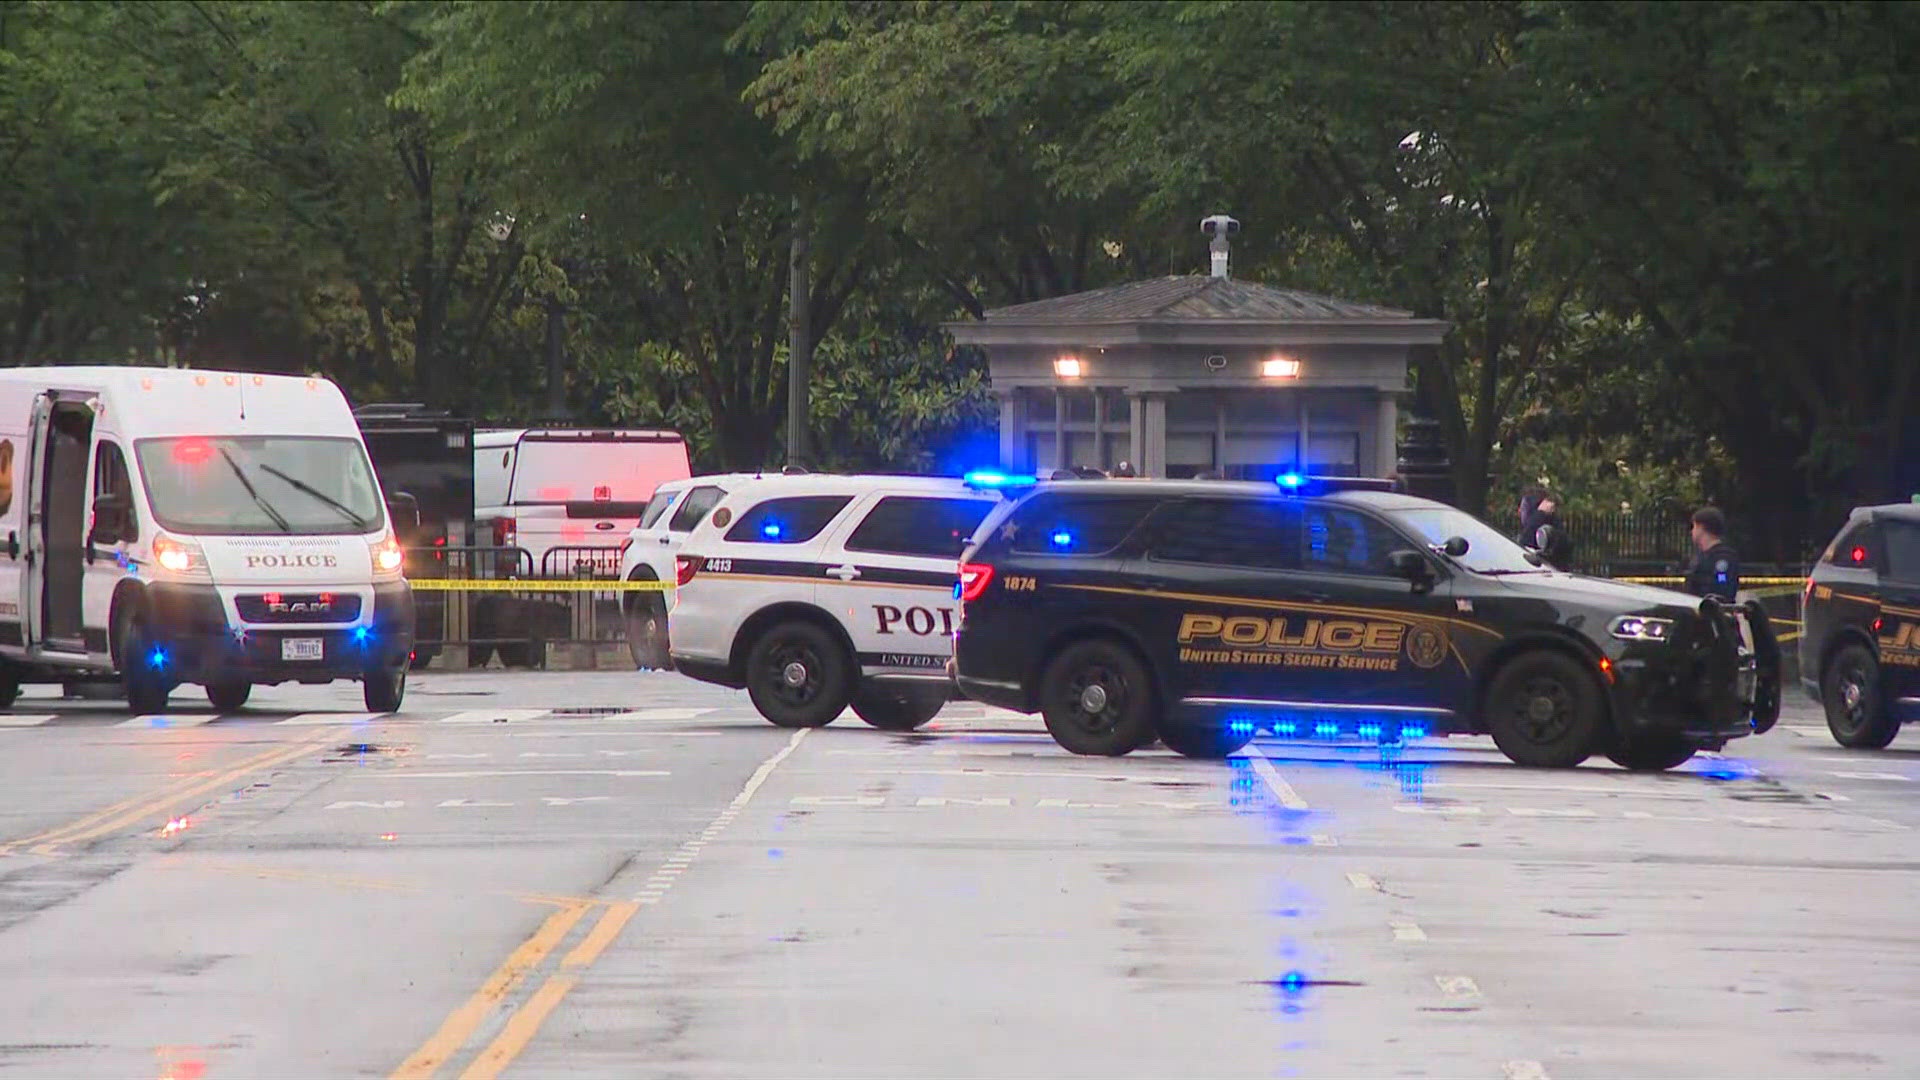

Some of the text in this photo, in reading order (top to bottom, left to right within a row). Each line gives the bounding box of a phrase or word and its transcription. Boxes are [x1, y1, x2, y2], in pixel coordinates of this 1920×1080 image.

[247, 554, 337, 568] POLICE
[706, 559, 732, 571] 4413
[1003, 576, 1036, 591] 1874
[269, 602, 331, 612] RAM
[1178, 613, 1404, 652] POLICE
[882, 654, 930, 665] UNITED
[1180, 648, 1398, 671] UNITED STATES SECRET SERVICE
